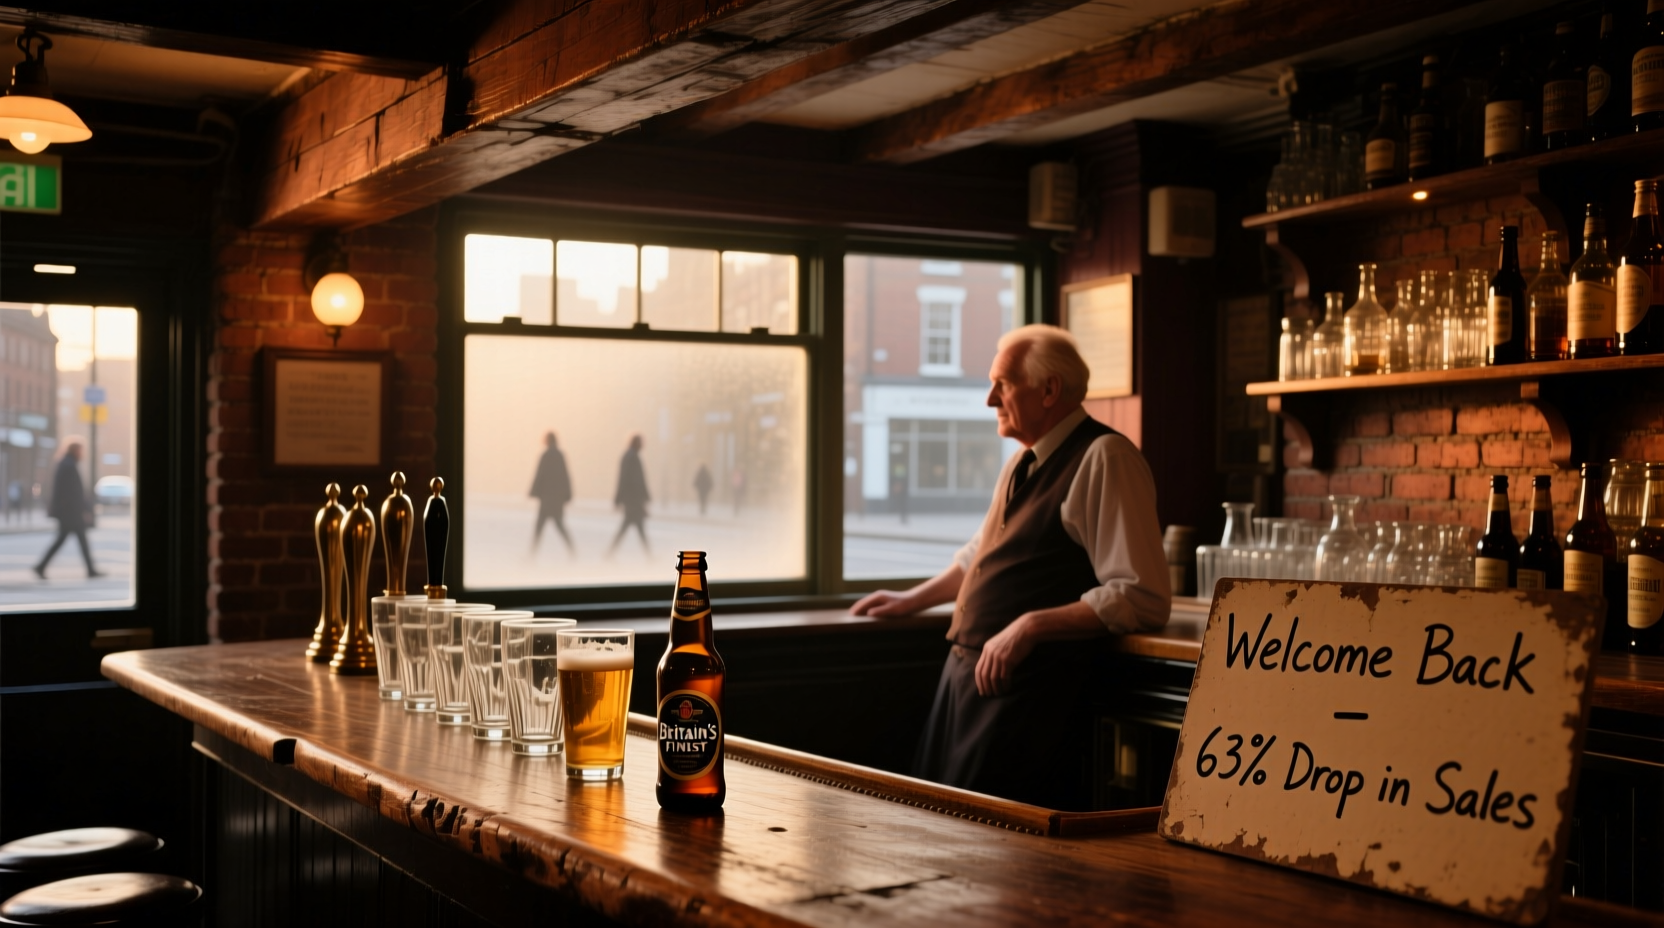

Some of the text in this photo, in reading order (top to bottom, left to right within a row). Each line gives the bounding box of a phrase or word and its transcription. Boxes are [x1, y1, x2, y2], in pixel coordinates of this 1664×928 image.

[1226, 612, 1536, 694] Welcome Back
[1196, 726, 1538, 830] 63% Drop in Sales
